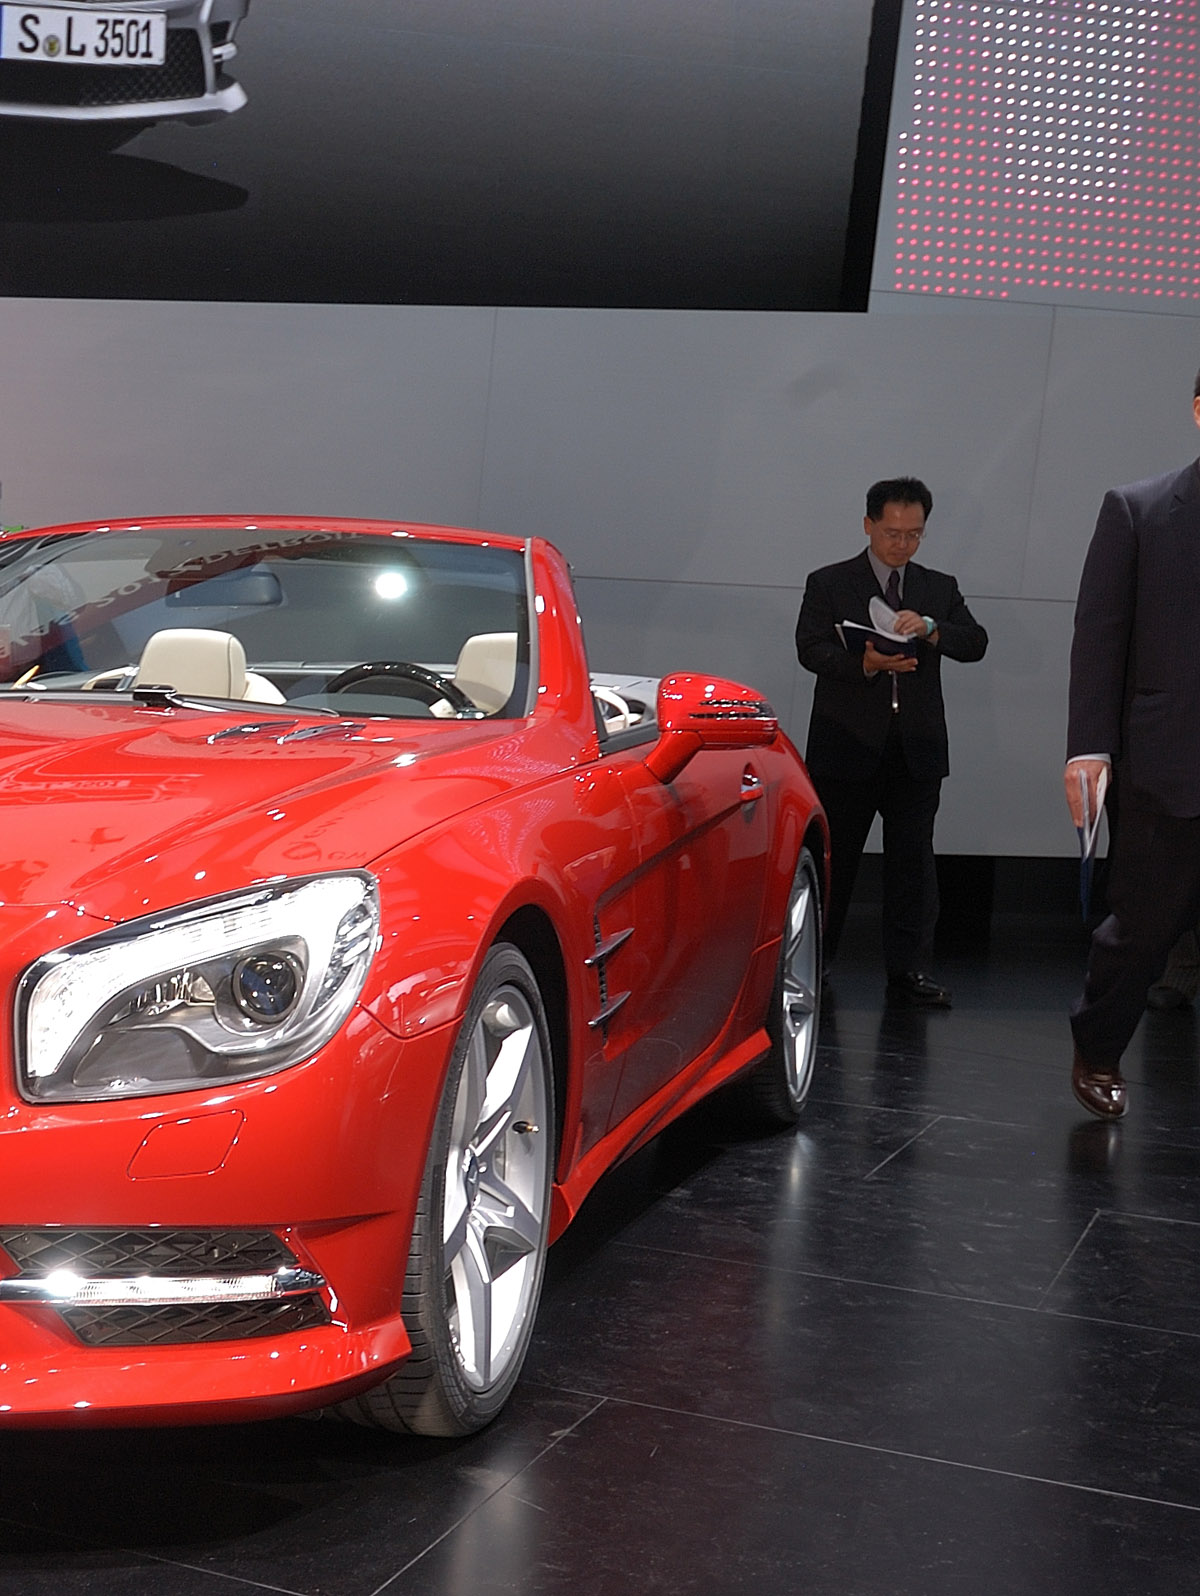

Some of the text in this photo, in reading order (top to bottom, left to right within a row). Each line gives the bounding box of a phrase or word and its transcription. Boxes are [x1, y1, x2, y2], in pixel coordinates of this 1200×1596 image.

[18, 13, 153, 58] S L 3501
